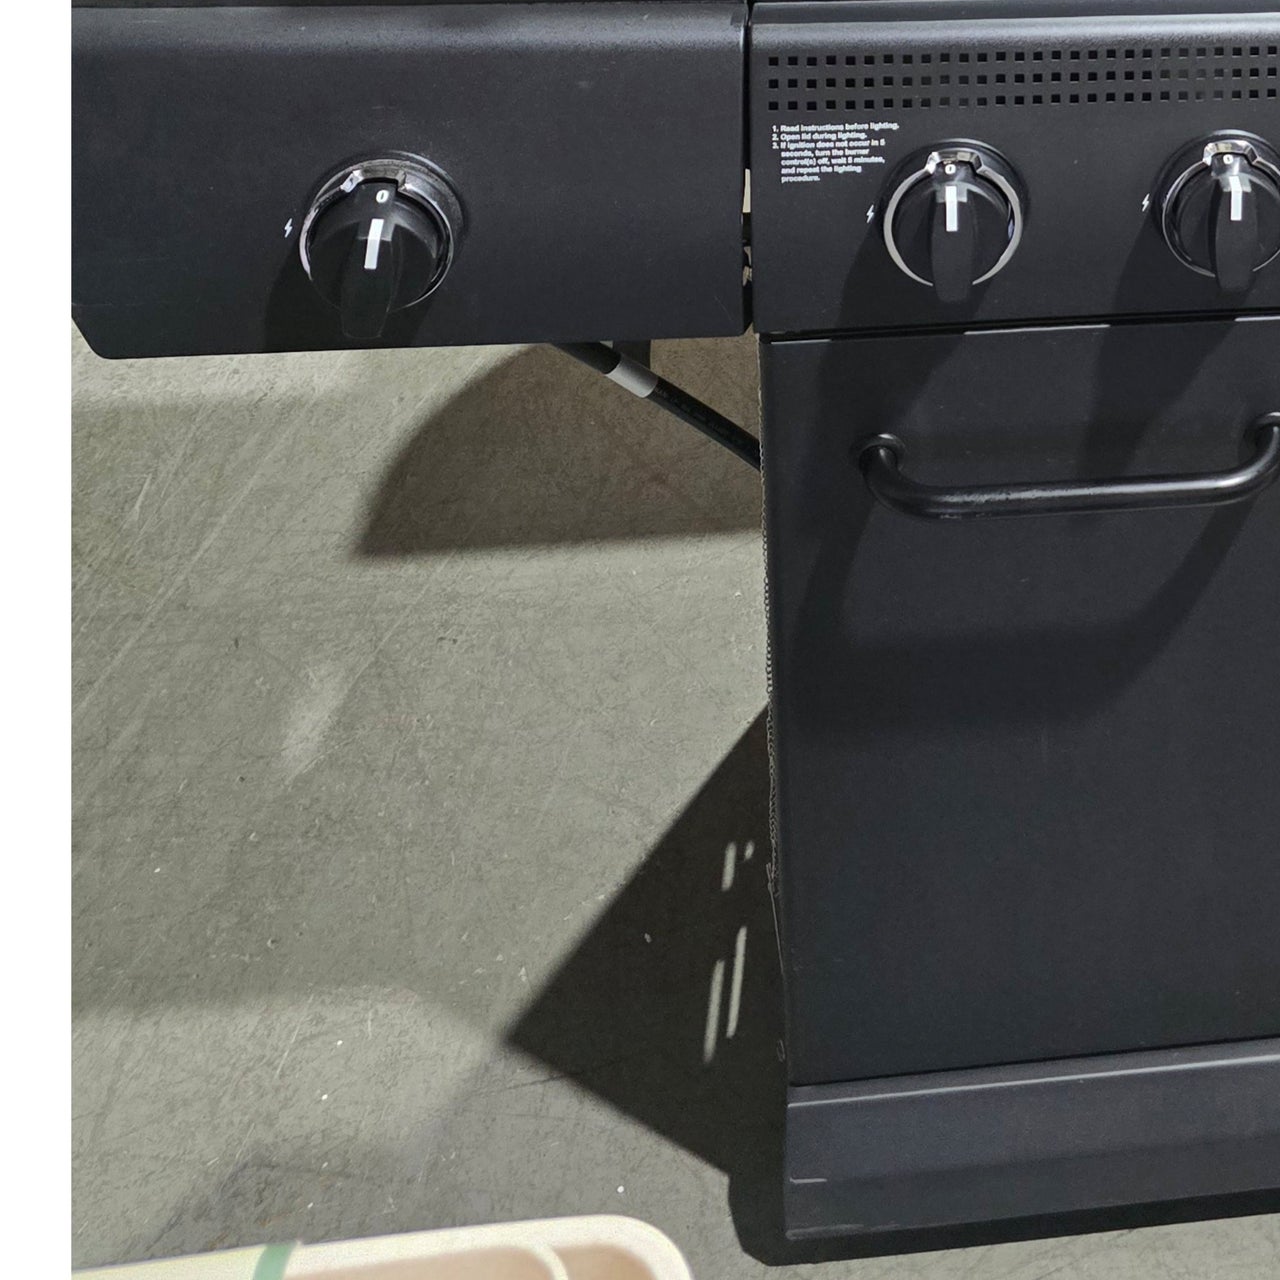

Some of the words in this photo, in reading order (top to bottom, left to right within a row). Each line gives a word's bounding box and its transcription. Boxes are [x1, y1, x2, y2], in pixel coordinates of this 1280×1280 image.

[780, 124, 800, 132] Read
[845, 122, 869, 130] before
[870, 122, 899, 131] lighting.
[780, 133, 800, 141] Open
[801, 132, 811, 140] lid
[812, 132, 837, 140] during
[838, 131, 867, 140] lighting.
[787, 140, 815, 149] ignition
[816, 140, 834, 148] does
[835, 140, 848, 148] not
[815, 149, 831, 157] turn
[845, 148, 869, 156] burner
[781, 158, 816, 166] control(s)
[781, 166, 796, 174] and
[796, 166, 820, 174] repeat
[820, 165, 833, 173] the
[833, 165, 862, 173] lighting
[781, 174, 820, 183] procedure.
